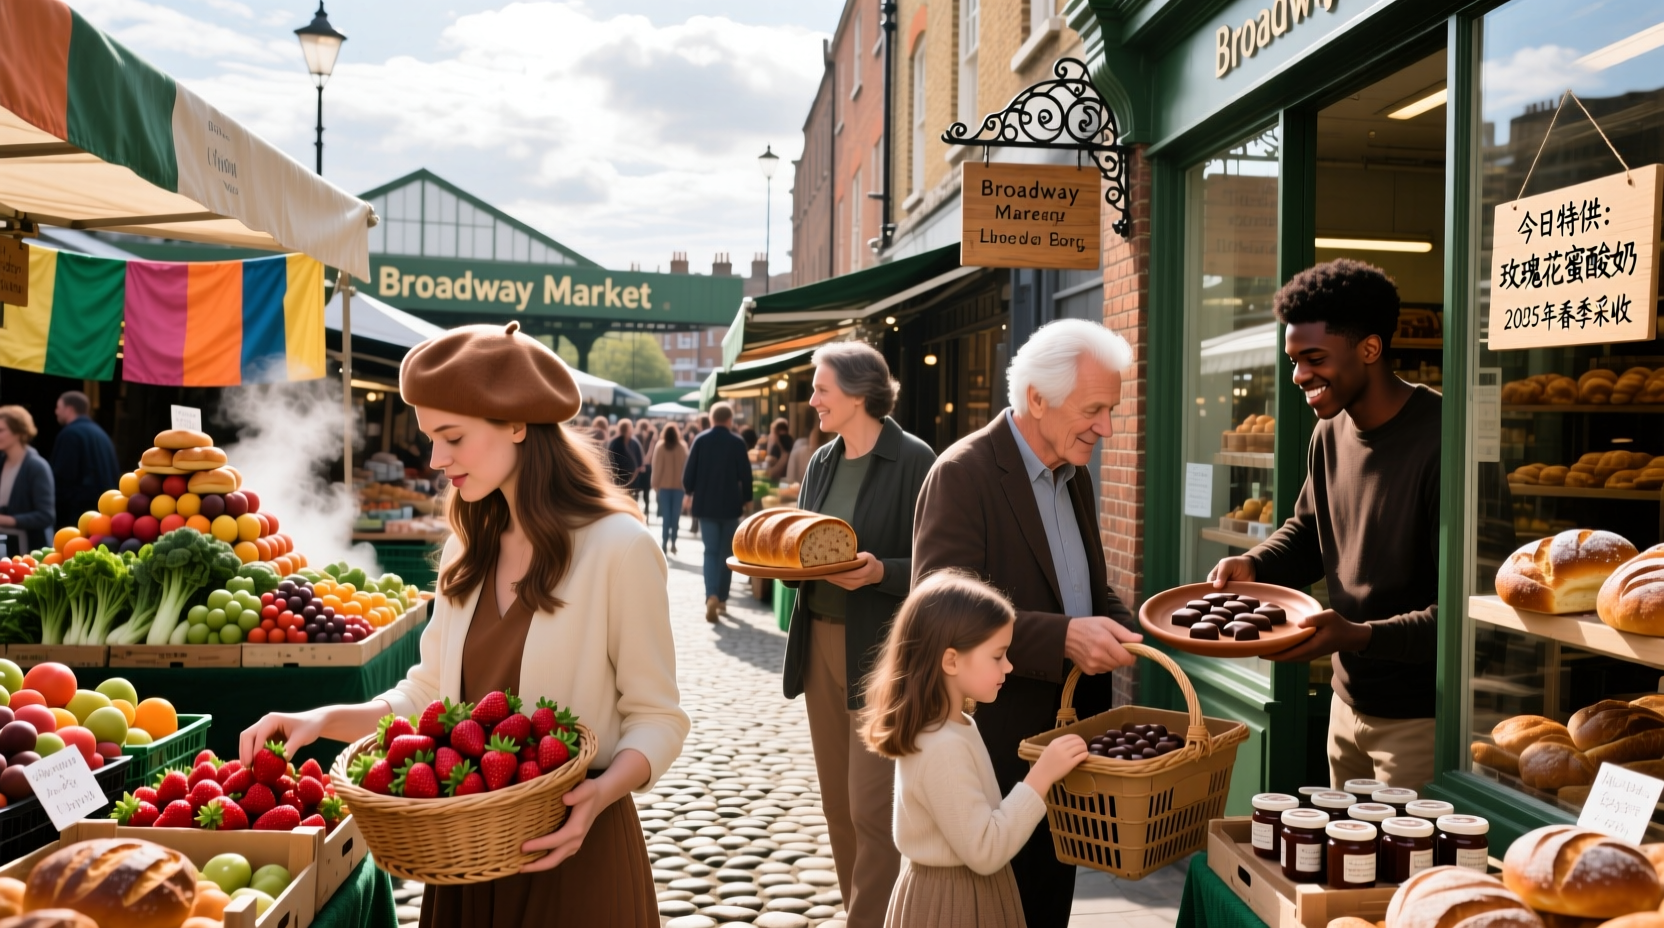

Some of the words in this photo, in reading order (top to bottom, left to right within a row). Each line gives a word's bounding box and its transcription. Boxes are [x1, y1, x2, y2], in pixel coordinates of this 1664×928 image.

[1216, 0, 1333, 79] Broadw
[981, 179, 1079, 207] Broadway
[1517, 197, 1611, 244] 今日特供：
[379, 265, 534, 312] Broadway
[543, 274, 652, 310] Market
[1499, 241, 1637, 290] 玫瑰花蜜酸奶
